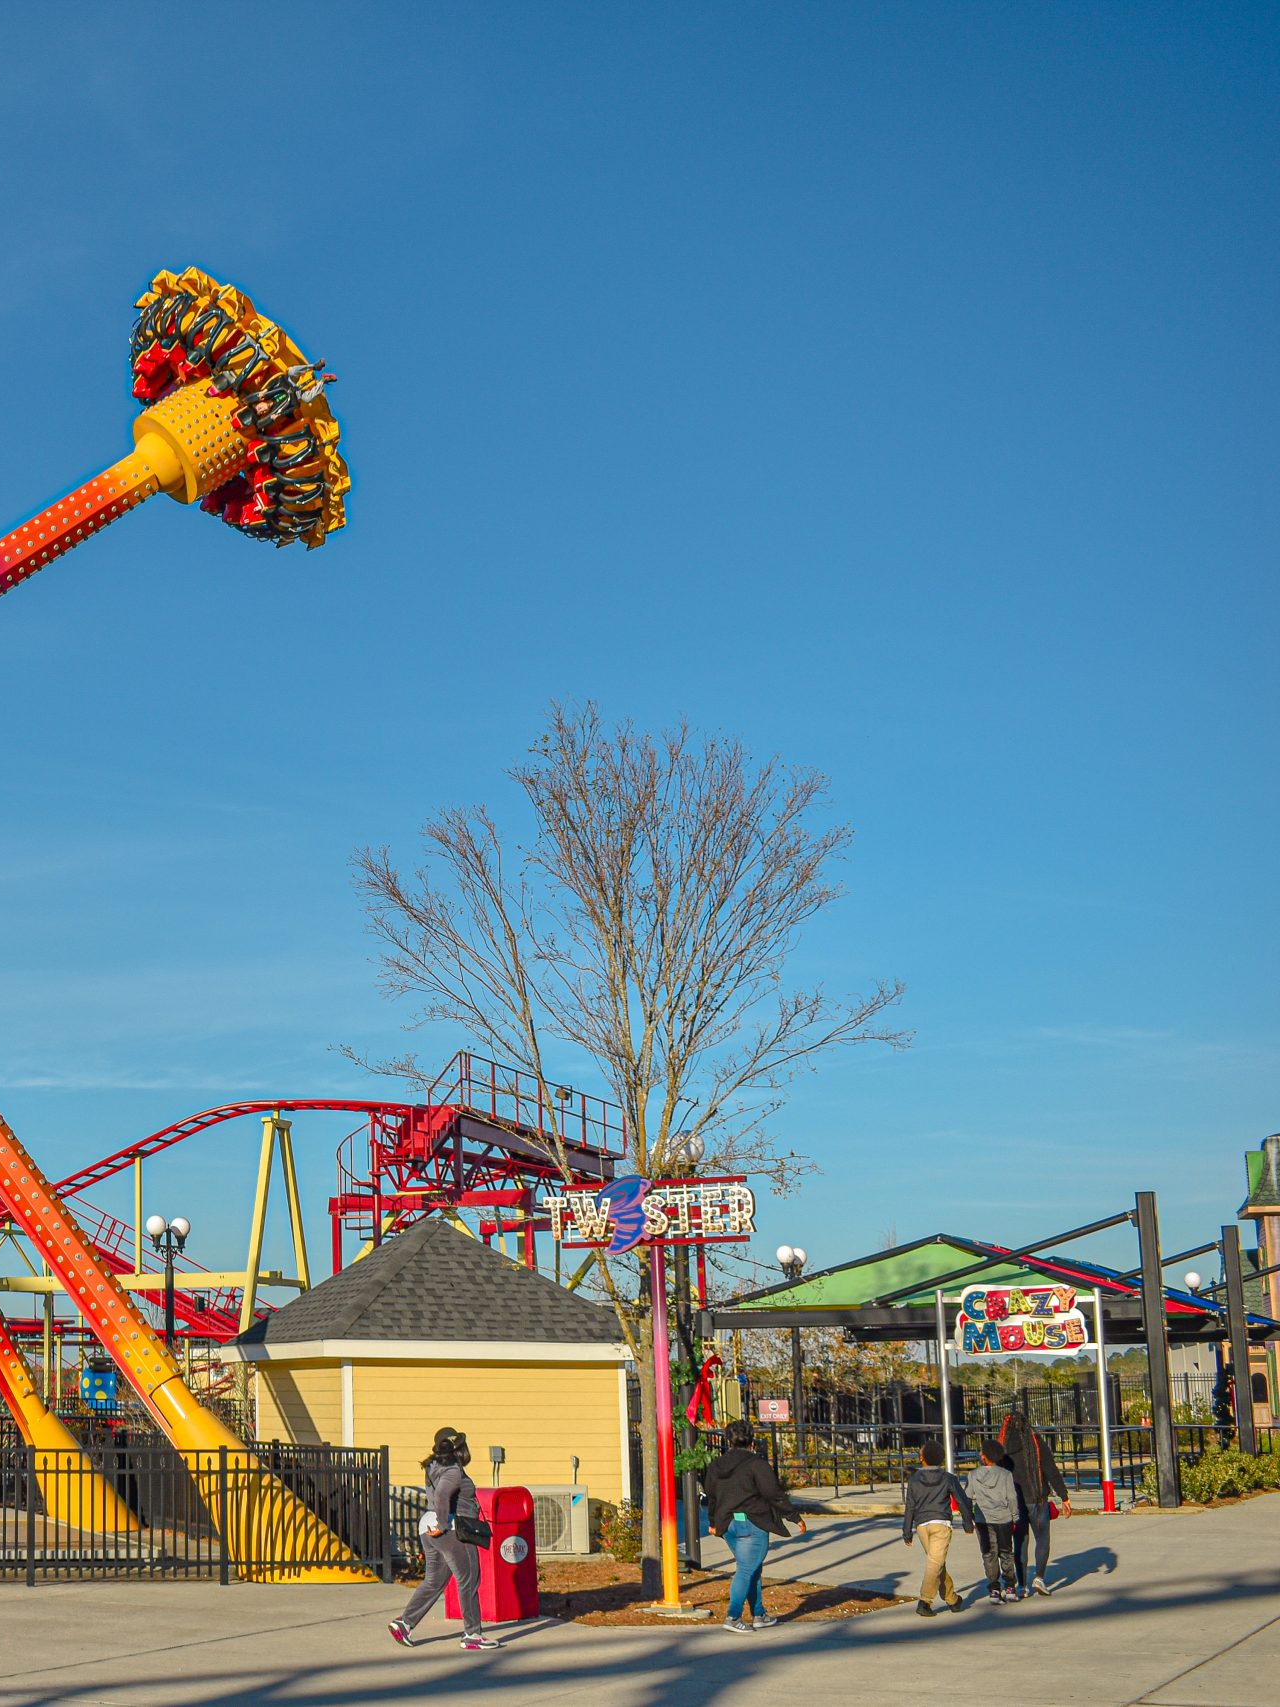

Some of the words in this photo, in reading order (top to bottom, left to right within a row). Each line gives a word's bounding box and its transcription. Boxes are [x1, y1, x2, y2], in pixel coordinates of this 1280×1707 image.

[543, 1185, 757, 1241] TWSTER
[962, 1286, 1077, 1322] CRAZY
[962, 1318, 1086, 1353] MOUSE
